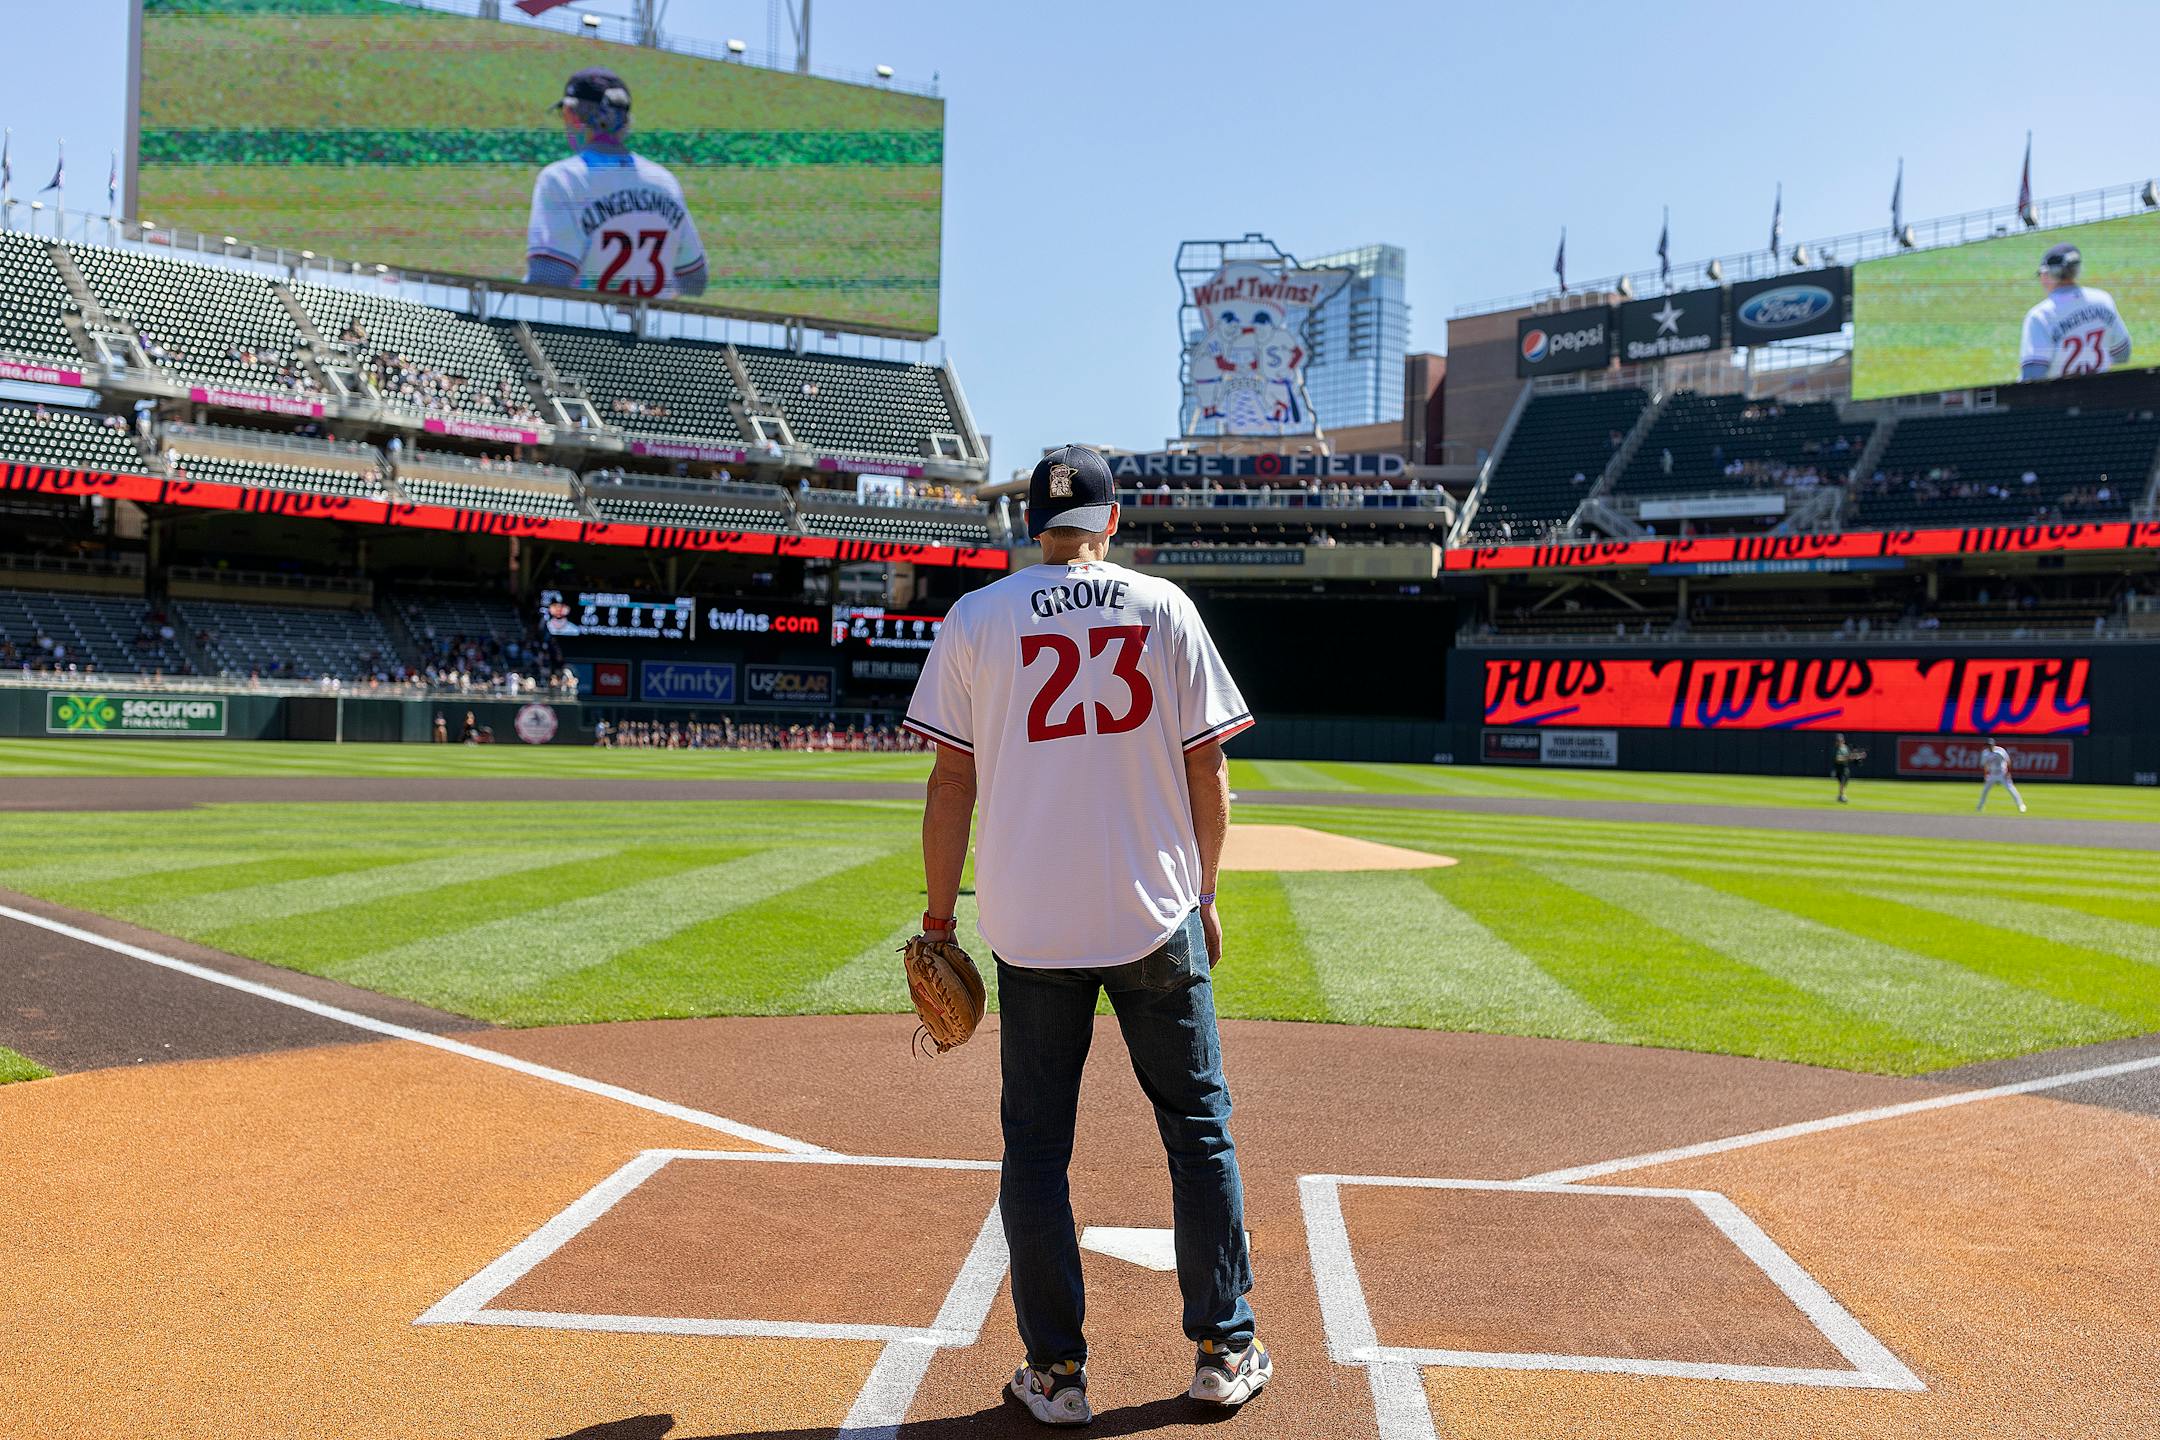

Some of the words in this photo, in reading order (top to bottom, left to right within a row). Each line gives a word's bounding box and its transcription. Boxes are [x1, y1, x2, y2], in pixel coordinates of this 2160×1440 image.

[582, 188, 685, 236] KLINGENSMITH
[598, 230, 668, 297] 23
[1247, 274, 1319, 302] Twins!
[1756, 293, 1816, 322] Ford
[1550, 323, 1604, 356] pepsi
[2062, 327, 2106, 377] 23
[1114, 453, 1242, 476] ARGET
[1290, 453, 1406, 476] FIELD
[1030, 579, 1129, 618] GROVE
[708, 607, 819, 633] twins.com
[647, 666, 730, 697] xfinity
[1020, 625, 1155, 743] 23
[121, 699, 217, 719] securian
[121, 717, 189, 729] FINANCIAL
